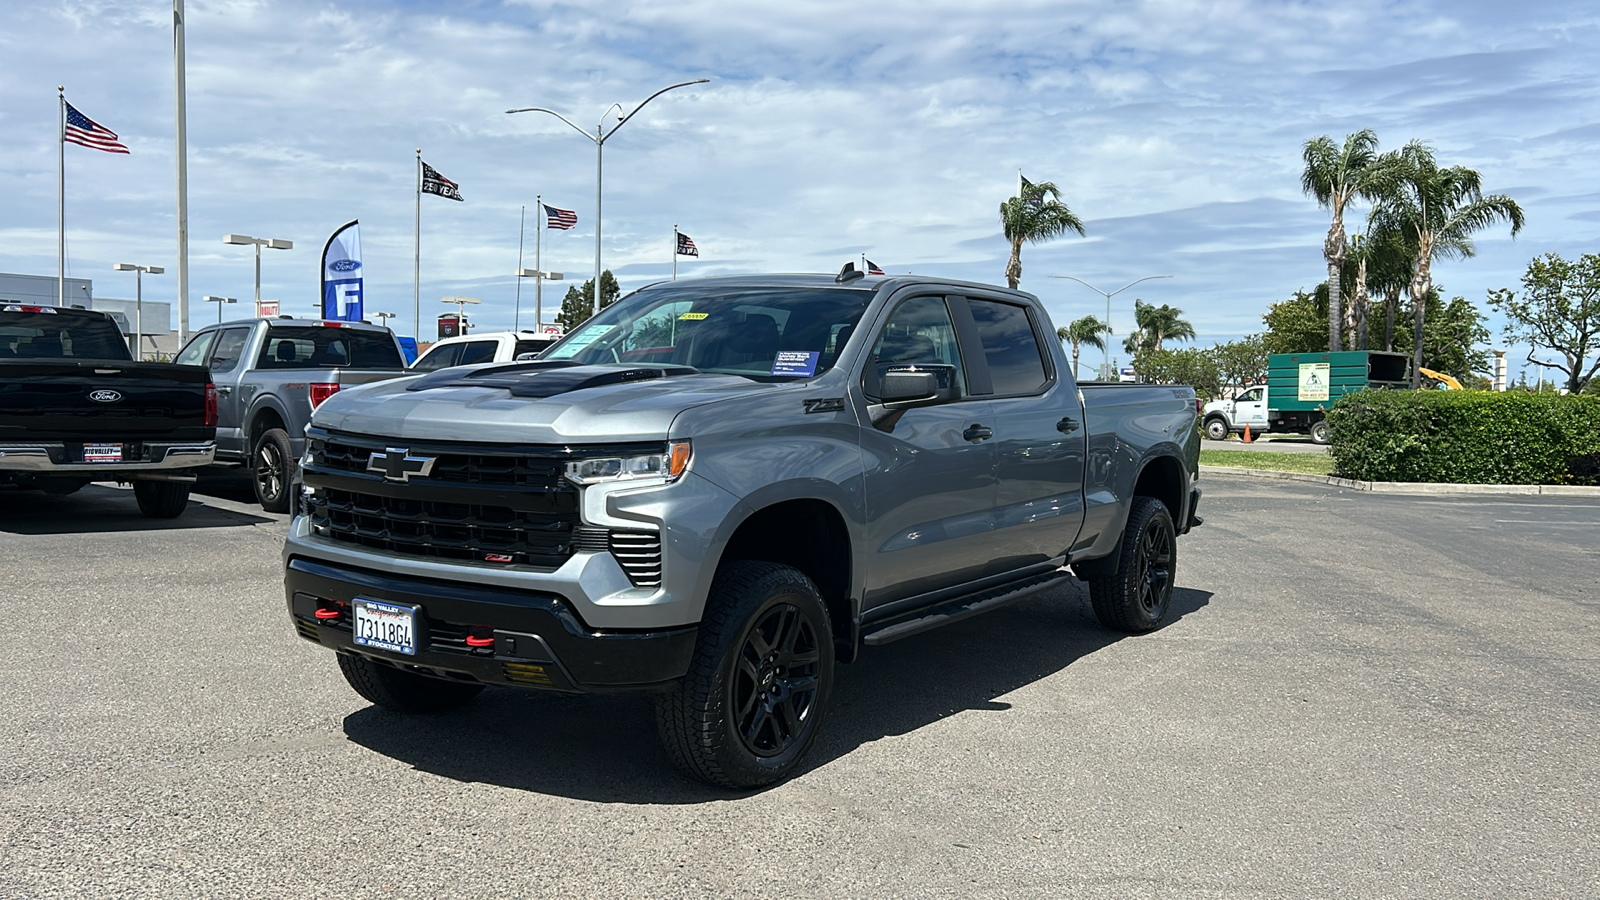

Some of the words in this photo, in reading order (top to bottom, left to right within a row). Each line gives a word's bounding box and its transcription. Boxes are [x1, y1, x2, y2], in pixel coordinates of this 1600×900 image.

[335, 261, 356, 271] Ford
[335, 283, 360, 317] F
[95, 391, 116, 400] Ford
[377, 604, 399, 613] VALLEY
[358, 616, 411, 646] 73118G4
[367, 640, 401, 652] STOCKTON
